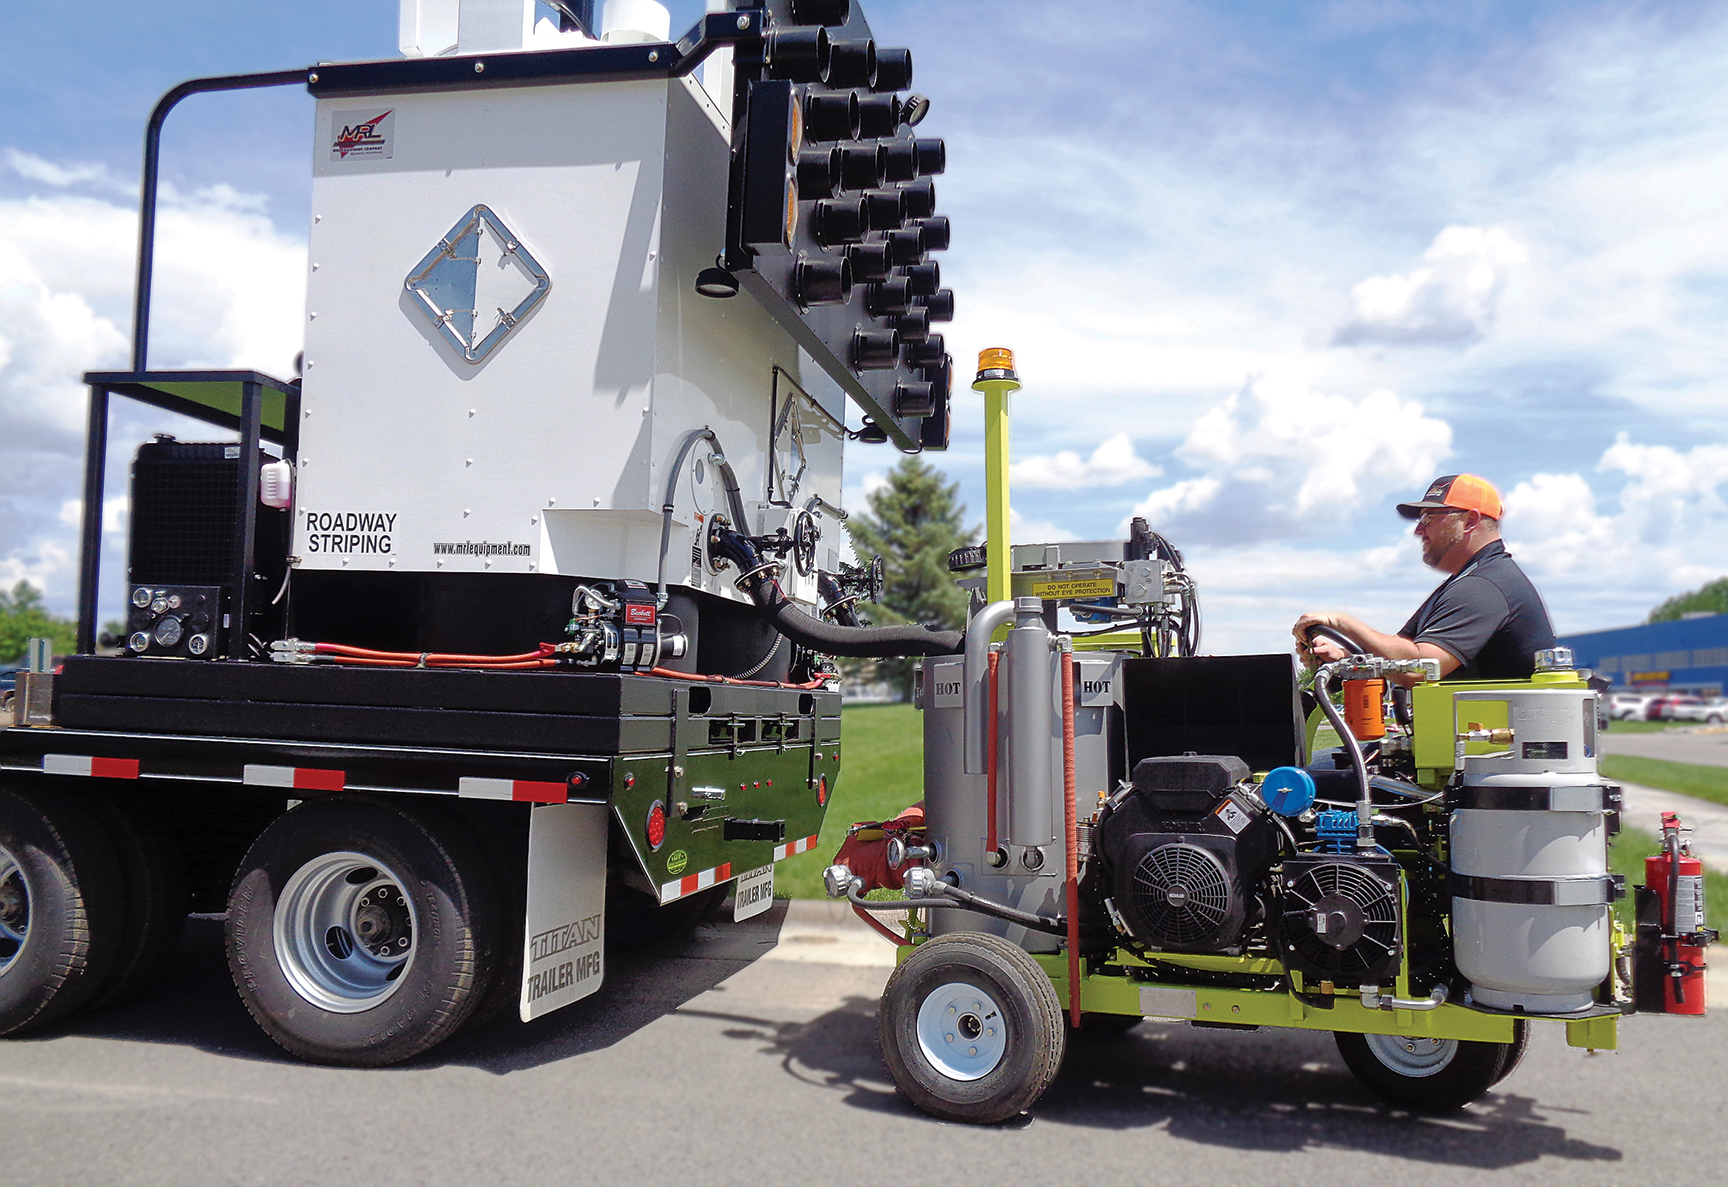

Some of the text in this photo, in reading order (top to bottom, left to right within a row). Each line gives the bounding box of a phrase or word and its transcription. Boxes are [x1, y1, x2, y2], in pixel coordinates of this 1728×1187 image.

[340, 124, 381, 140] MRL
[306, 512, 398, 532] ROADWAY
[308, 533, 392, 554] STRIPING
[433, 540, 531, 557] www.mrlequipment.com
[1075, 587, 1111, 595] PROTECTION
[935, 682, 961, 695] HOT
[1083, 680, 1111, 694] HOT
[736, 880, 772, 910] TRAILER MFG
[530, 914, 602, 963] TITAN
[527, 951, 601, 1004] TRAILER MFG
